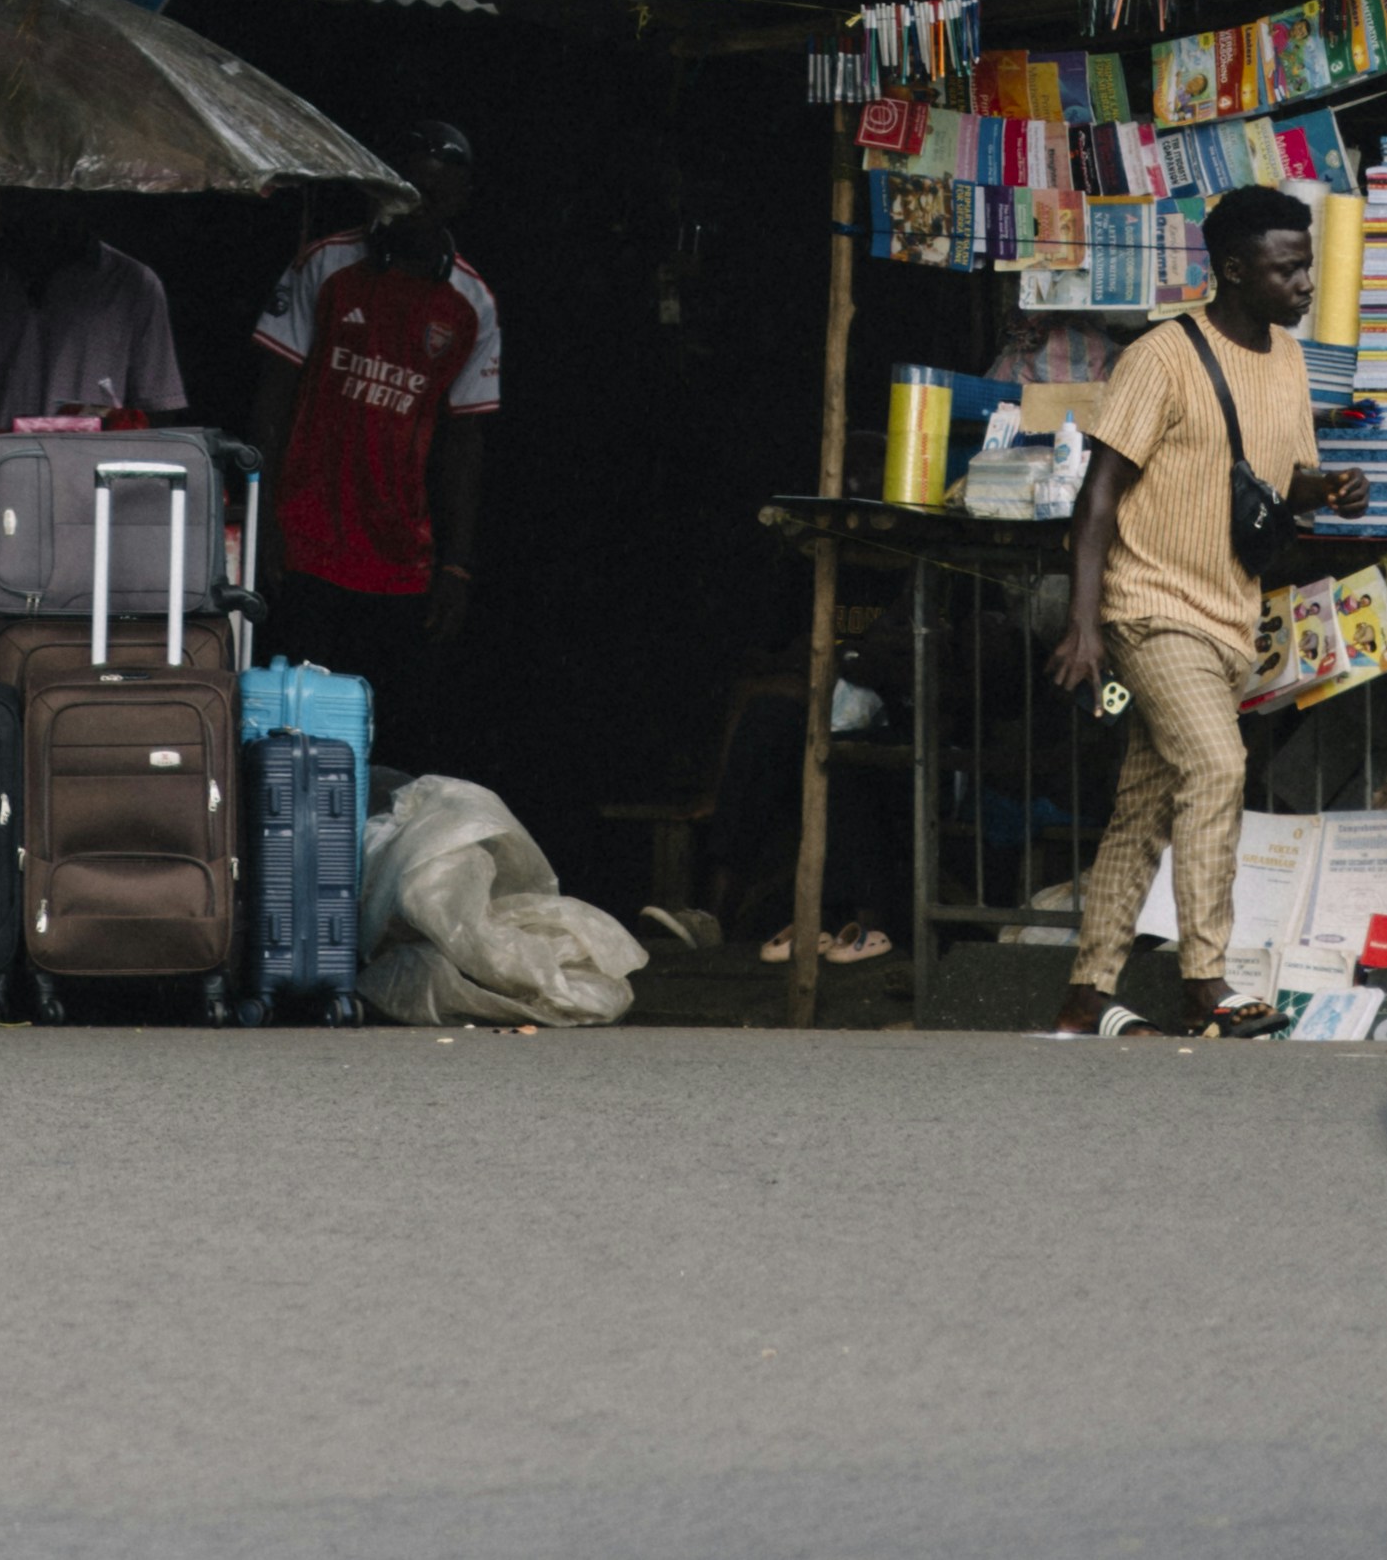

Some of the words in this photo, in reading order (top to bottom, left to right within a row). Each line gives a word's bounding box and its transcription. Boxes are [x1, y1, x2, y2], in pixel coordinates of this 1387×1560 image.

[1245, 27, 1253, 66] Lantern
[1171, 138, 1180, 150] THE
[1162, 140, 1178, 185] COMPANION
[956, 184, 965, 201] FOR
[964, 185, 972, 224] PRIMARY
[957, 203, 965, 234] SIERRA
[1109, 225, 1117, 255] LETTR
[1095, 246, 1104, 300] CANDIDATES
[1109, 257, 1118, 292] WRITING
